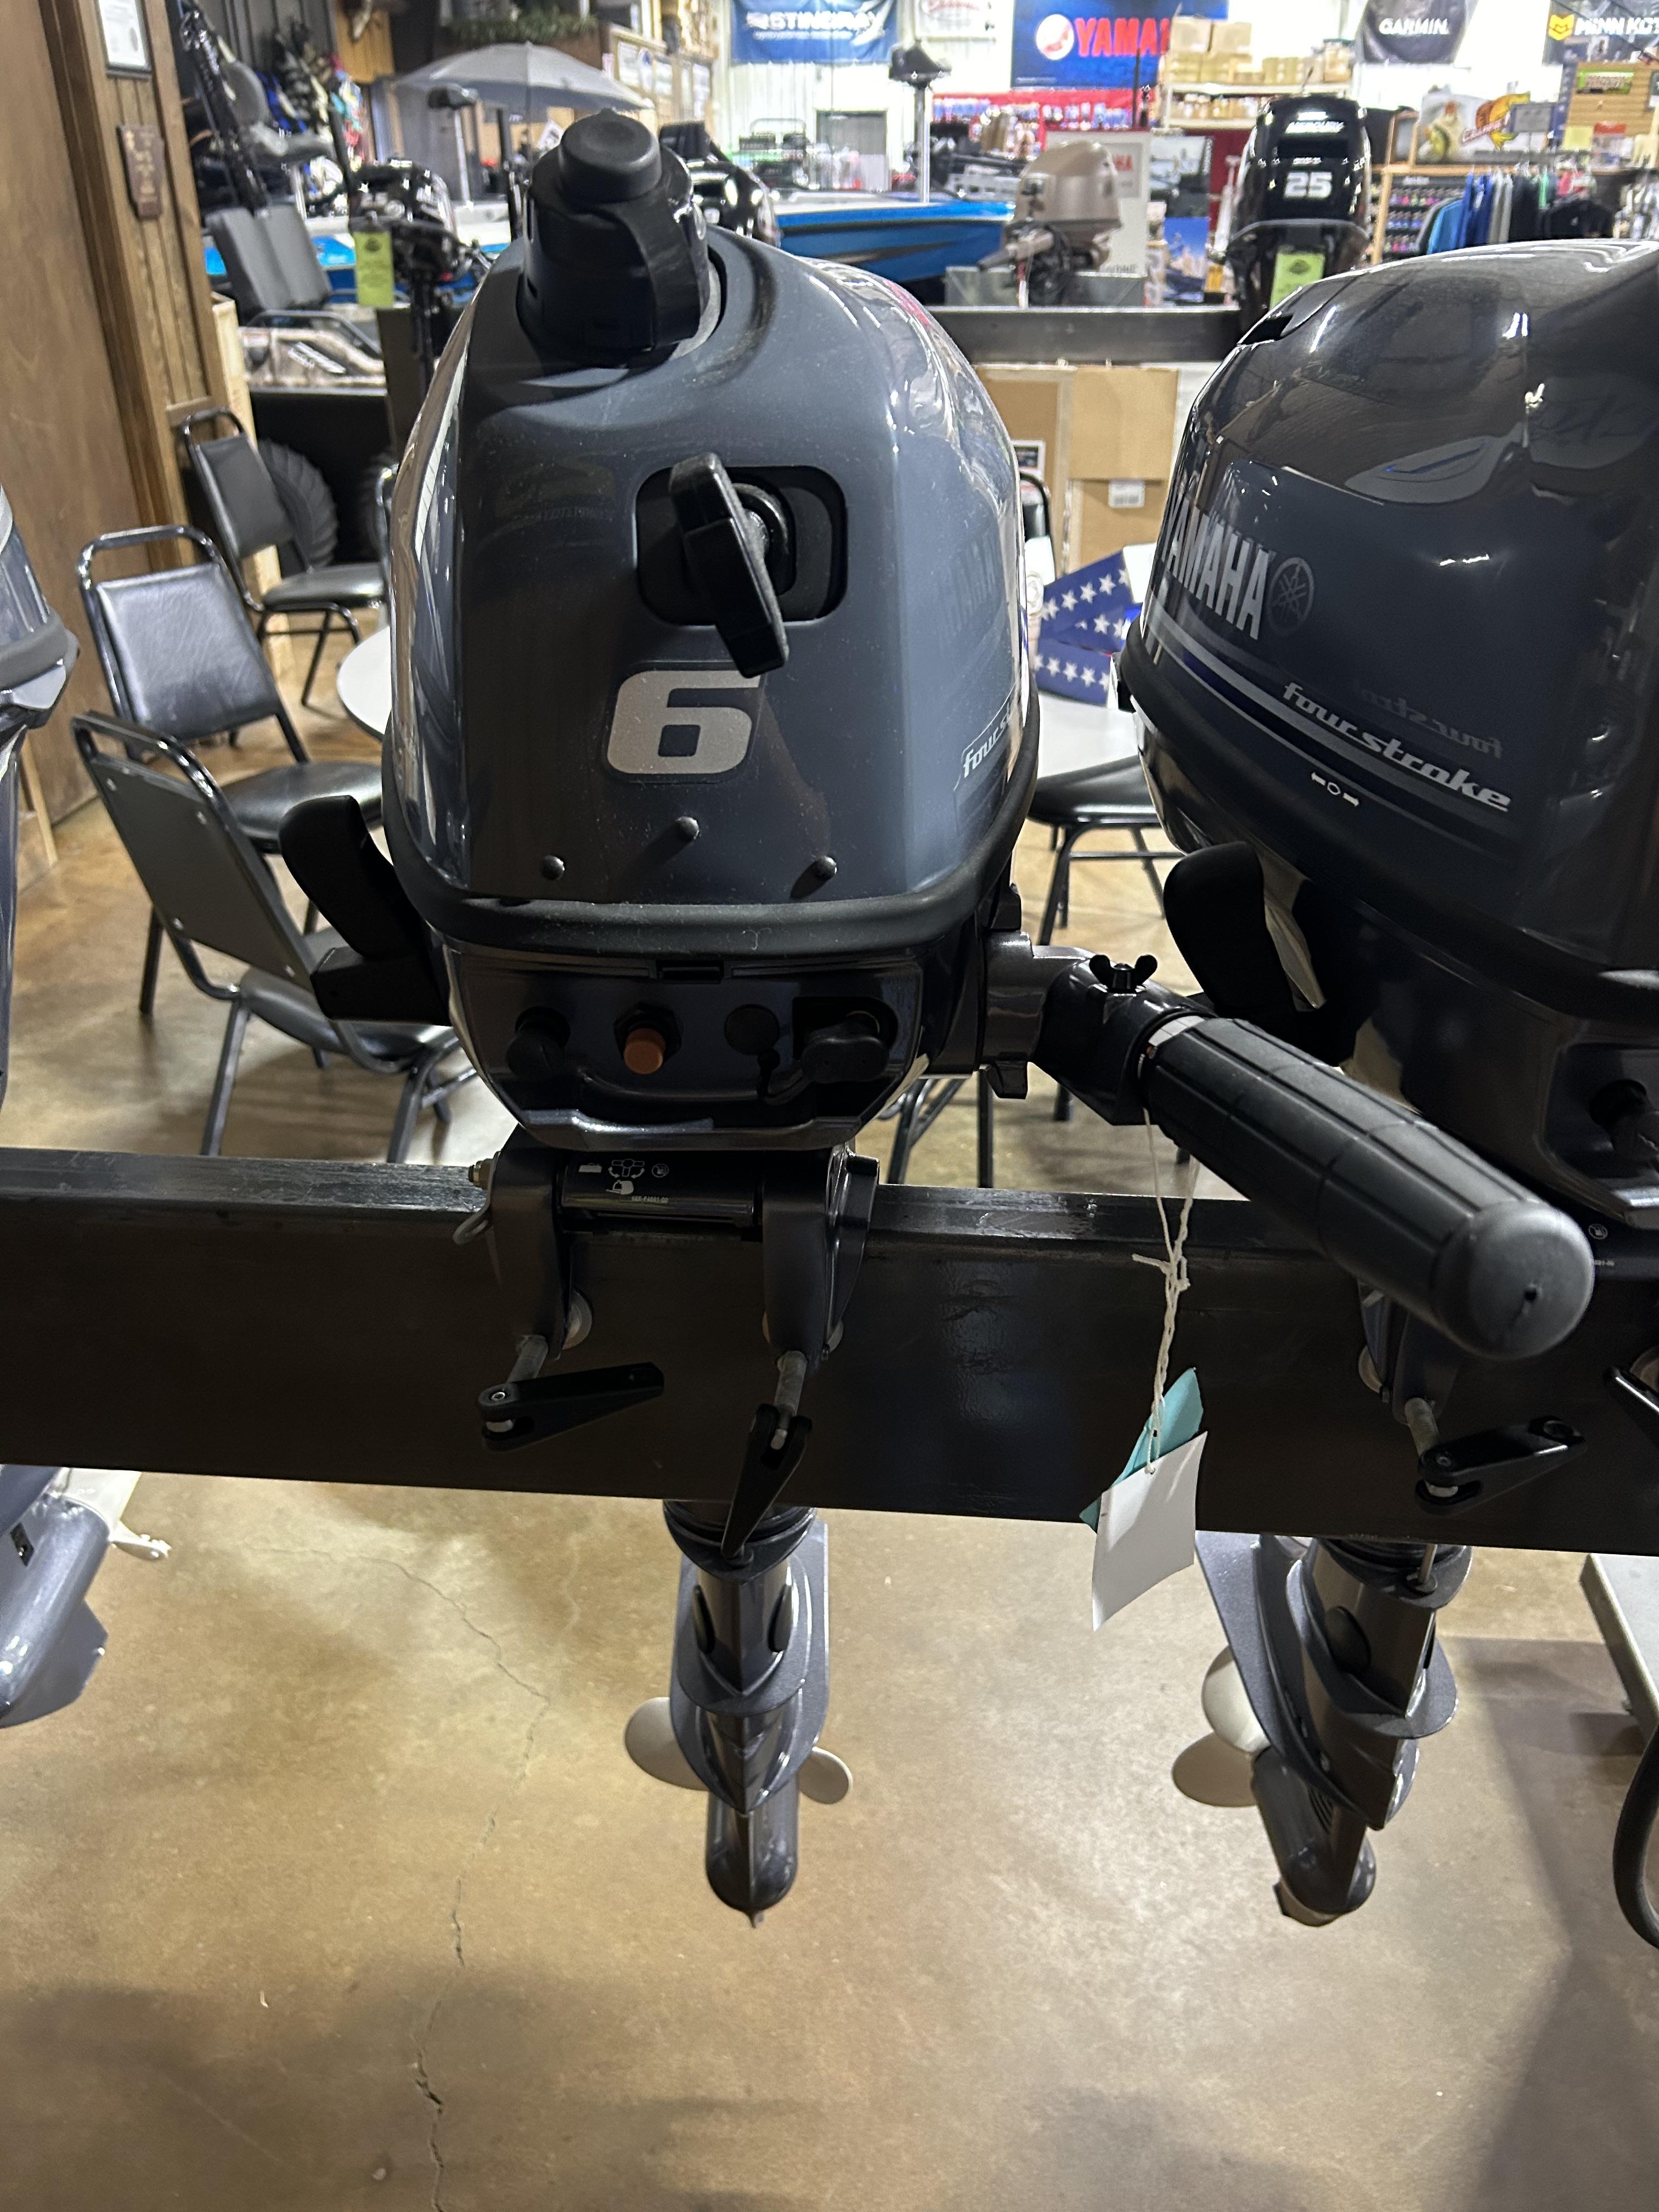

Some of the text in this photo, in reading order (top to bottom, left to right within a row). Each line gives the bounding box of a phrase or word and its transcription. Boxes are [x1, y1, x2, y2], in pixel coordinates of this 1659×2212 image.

[1379, 18, 1450, 35] GARMIN
[1626, 17, 1659, 35] KO
[1284, 171, 1333, 198] 25
[1160, 486, 1269, 641] YAMAHA
[607, 670, 761, 774] 6
